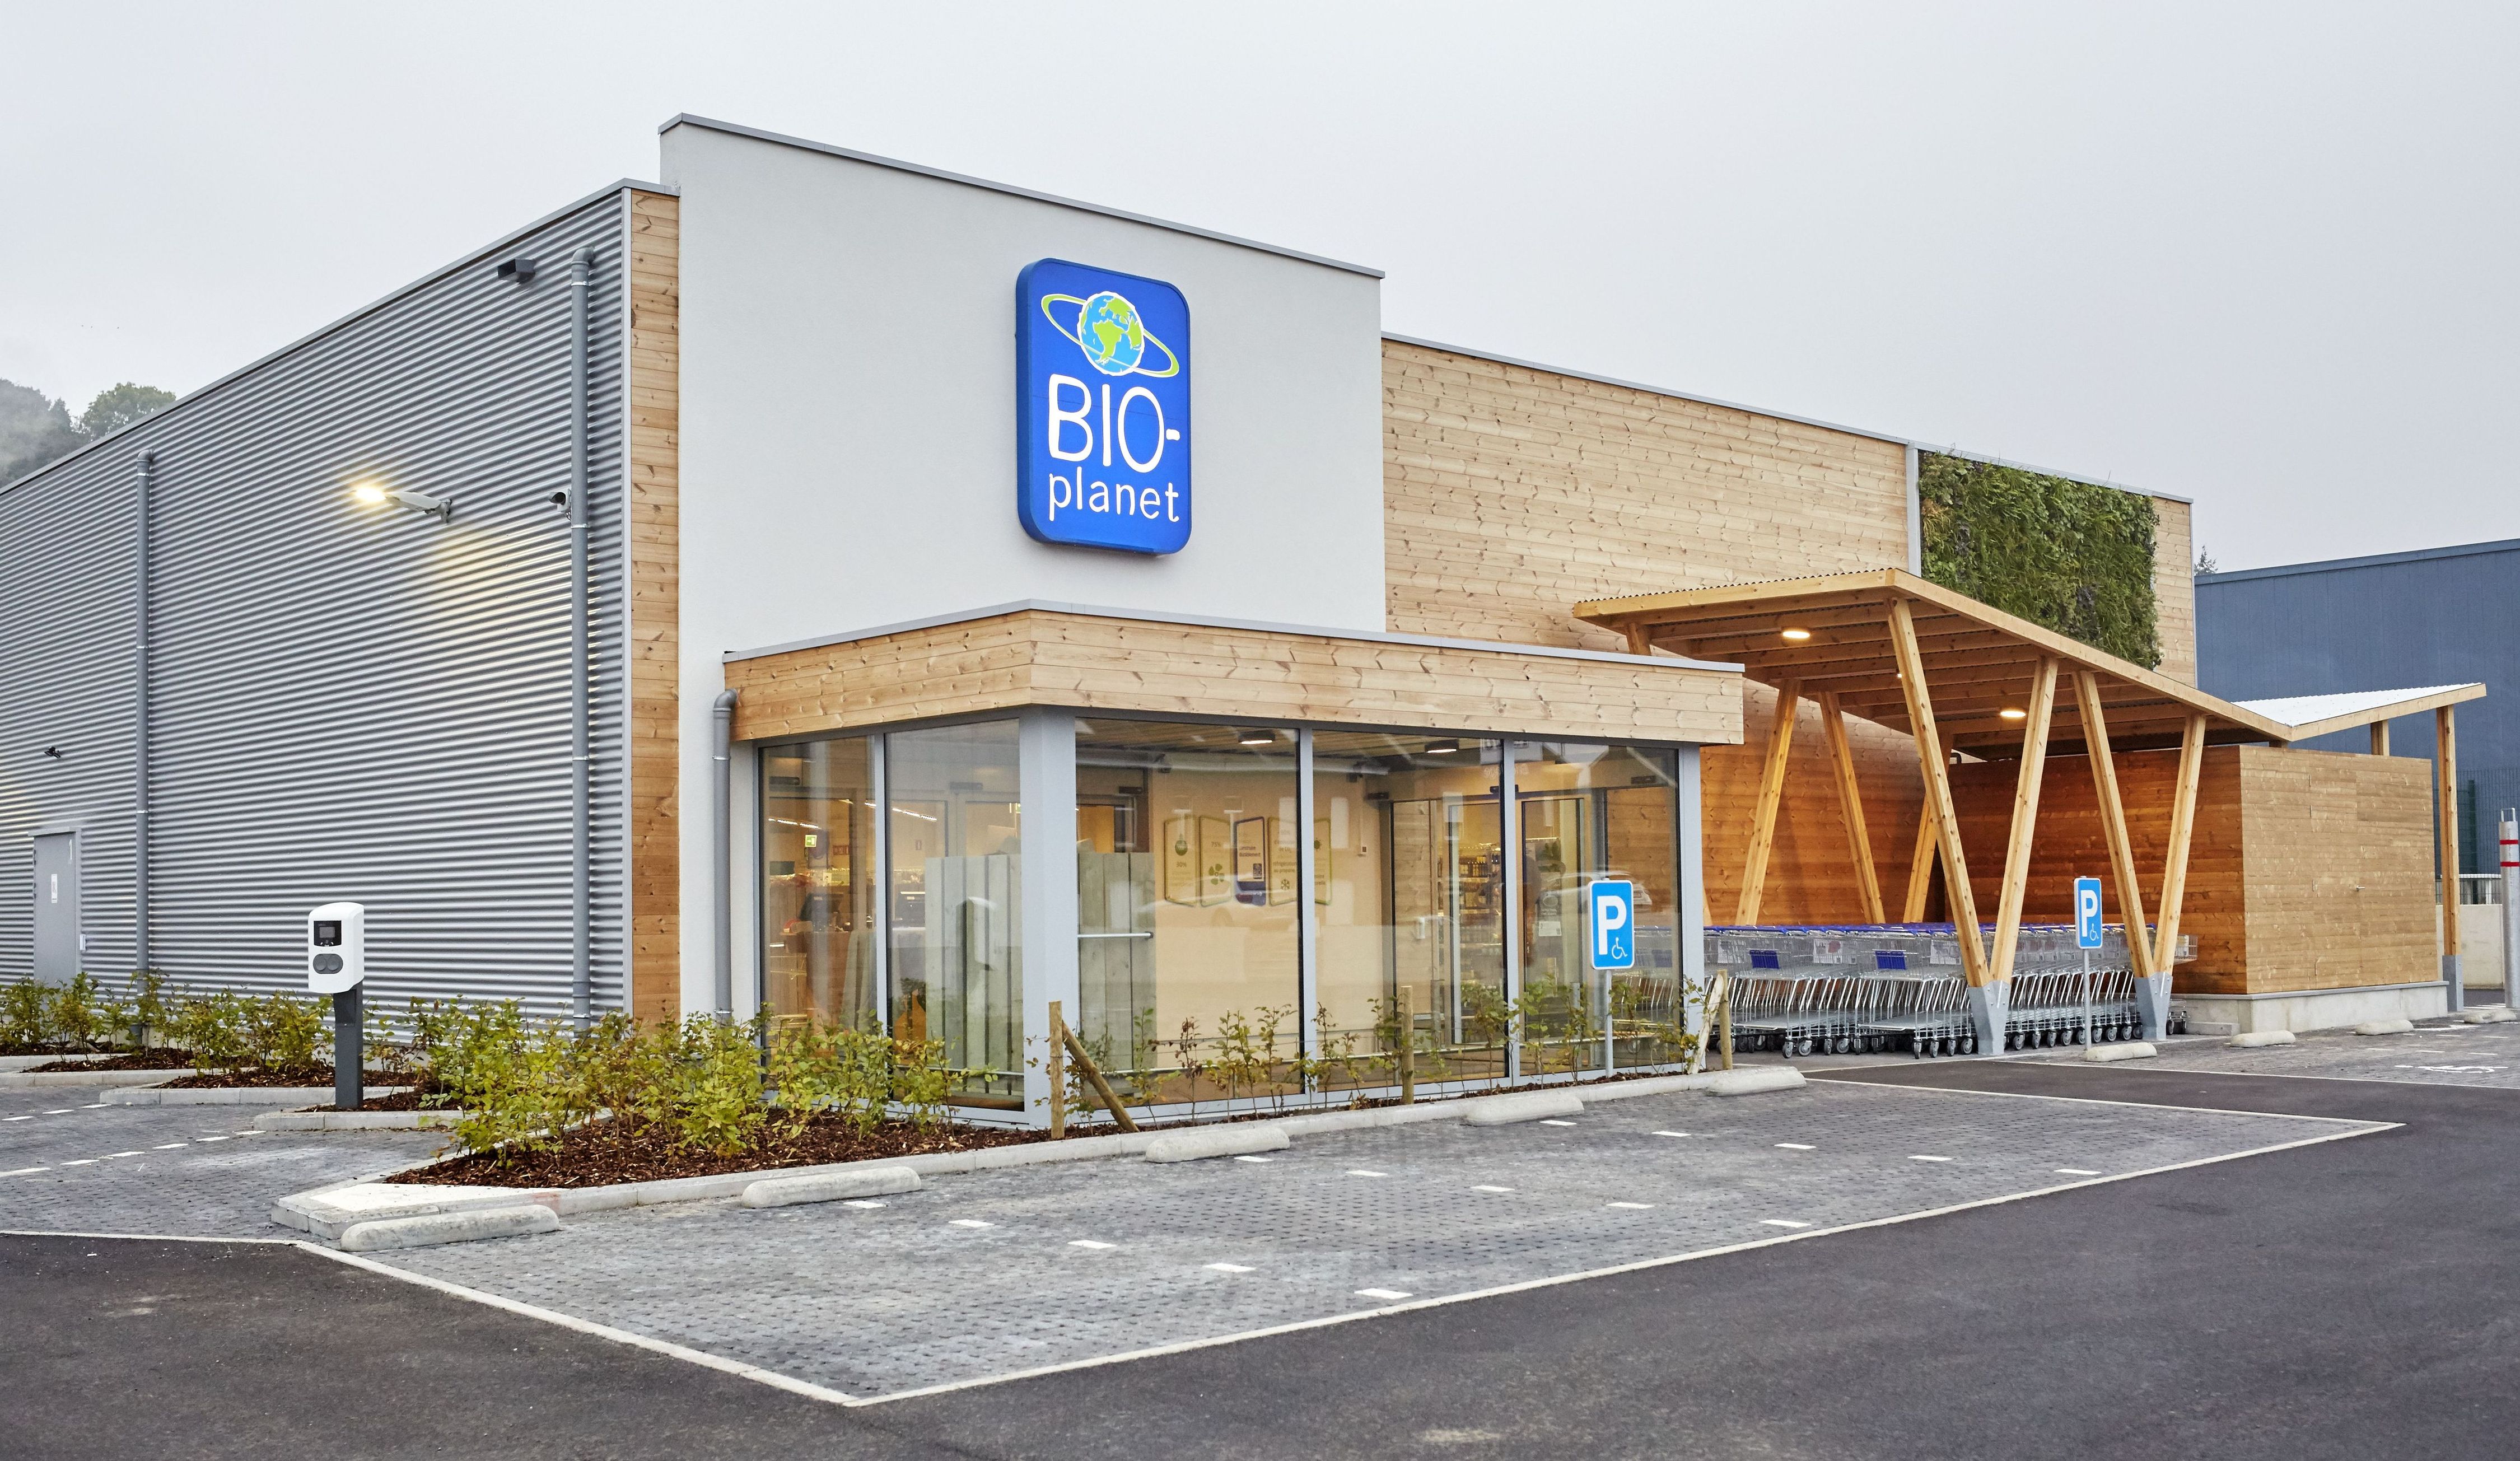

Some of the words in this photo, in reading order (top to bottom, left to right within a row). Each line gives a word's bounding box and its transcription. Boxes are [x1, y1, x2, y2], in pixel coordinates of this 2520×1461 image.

[1048, 374, 1180, 473] BIO-
[1049, 466, 1179, 522] planet
[1597, 895, 1627, 955] P
[2080, 890, 2098, 937] P
